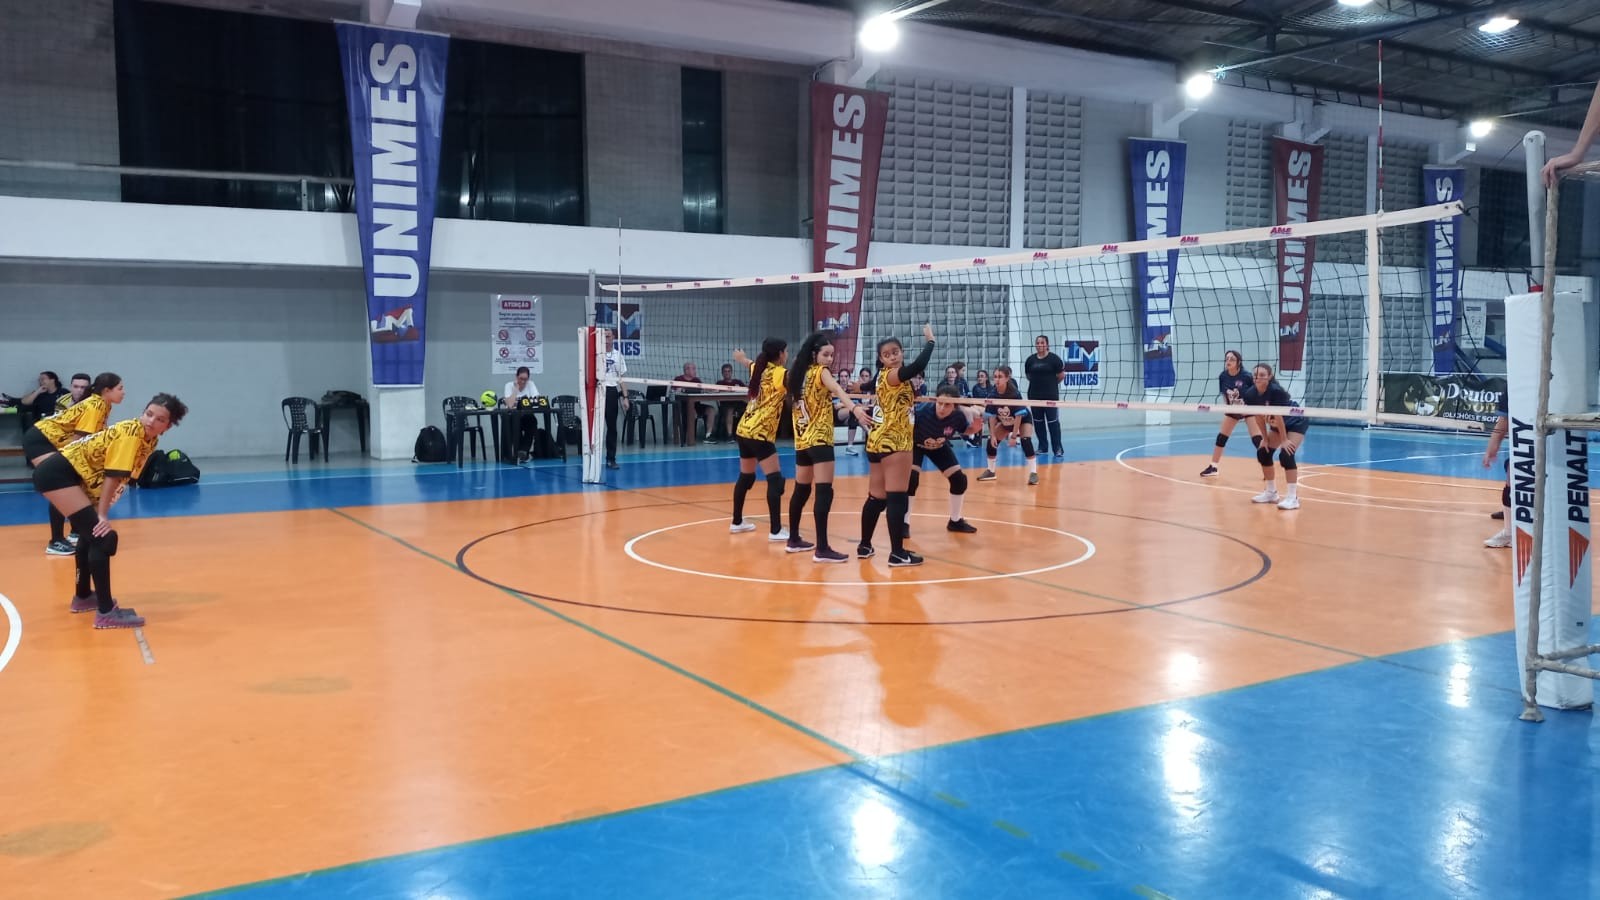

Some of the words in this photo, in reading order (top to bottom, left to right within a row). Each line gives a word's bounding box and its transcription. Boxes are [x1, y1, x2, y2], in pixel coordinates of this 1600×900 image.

[369, 42, 420, 298] UNIMES
[822, 92, 867, 304] UNIMES
[1282, 149, 1312, 314] UNIMES
[1063, 373, 1099, 386] UNIMES
[1447, 383, 1503, 403] Doutor
[1512, 416, 1536, 524] PENALTY
[1566, 427, 1590, 524] PENALT
